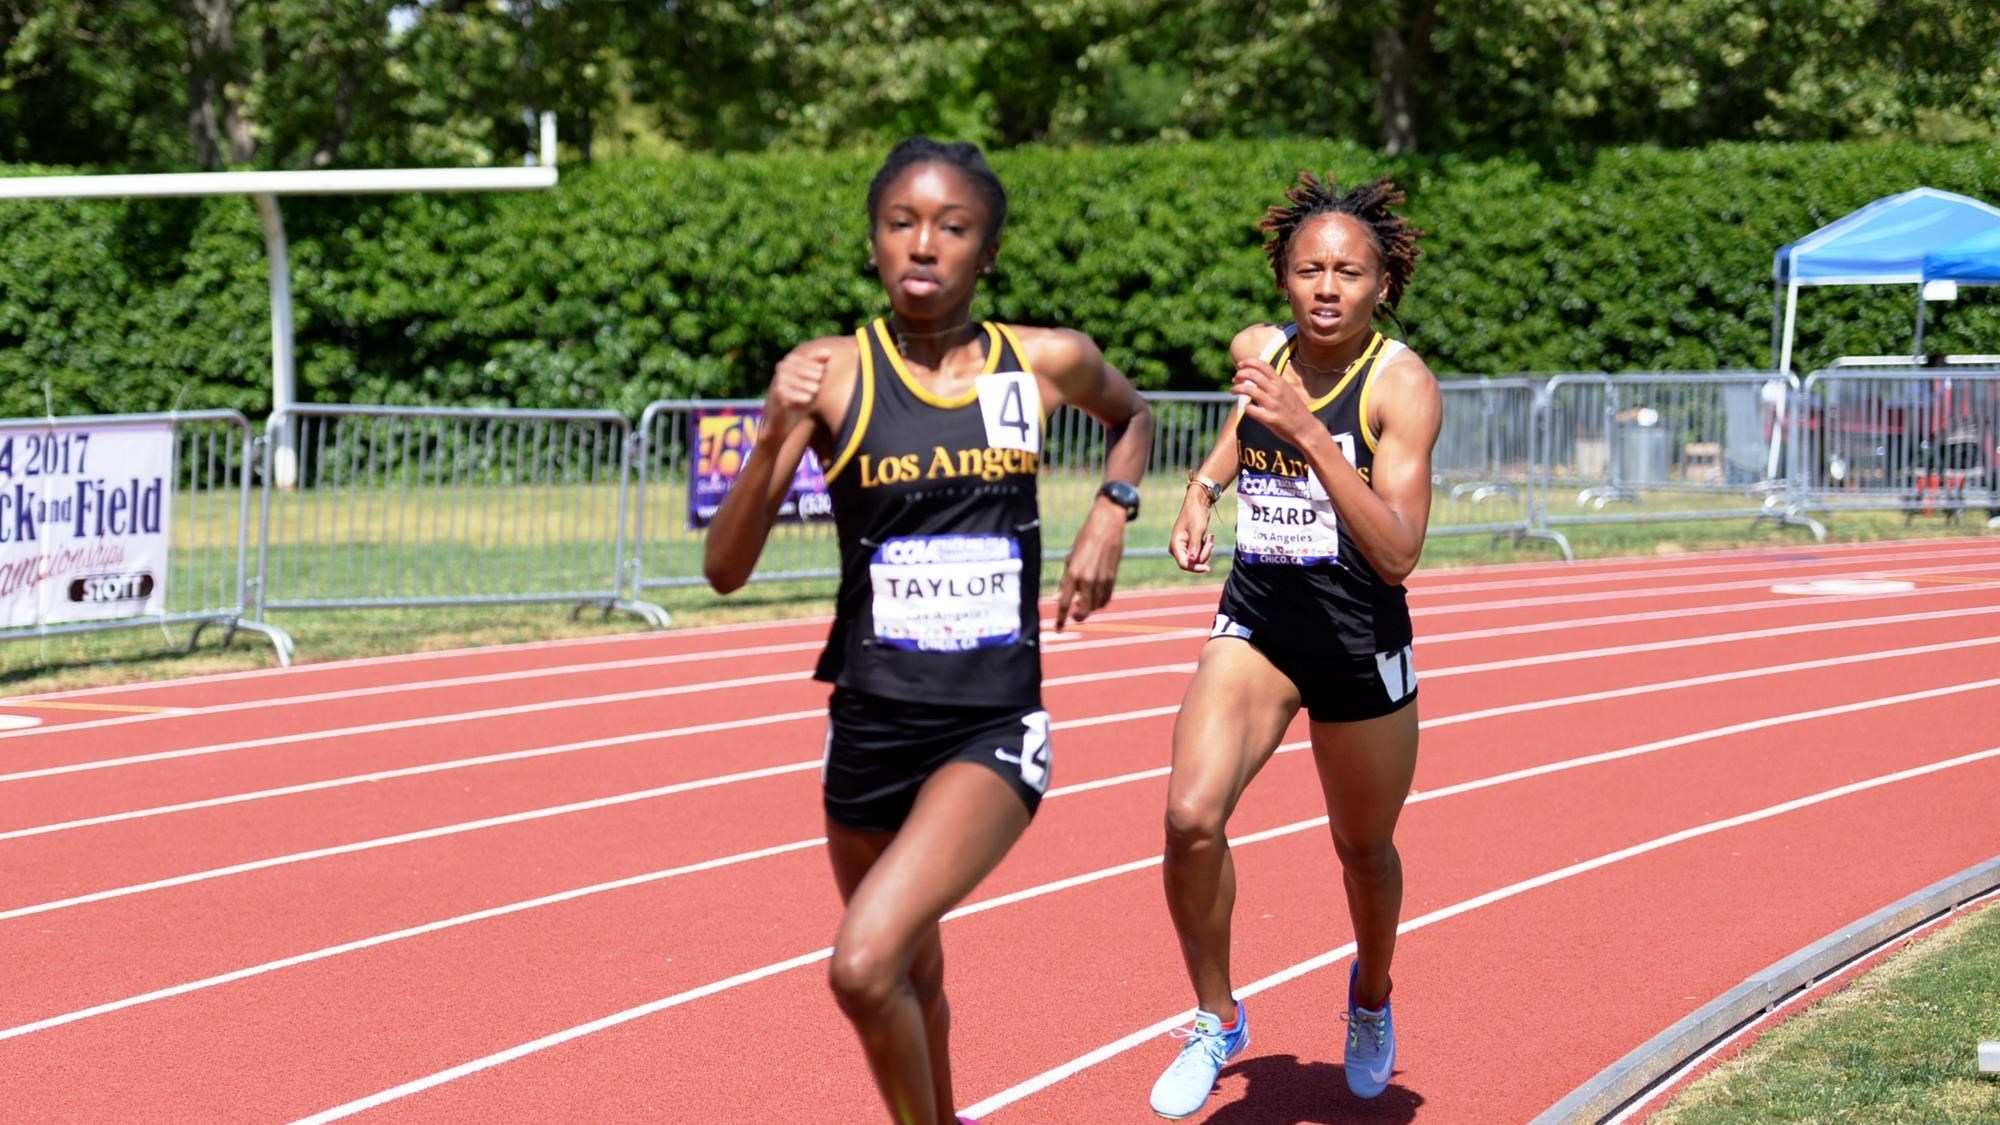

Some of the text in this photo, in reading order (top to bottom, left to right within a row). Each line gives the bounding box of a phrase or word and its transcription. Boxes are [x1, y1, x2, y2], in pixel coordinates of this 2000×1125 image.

[1000, 381, 1029, 442] 4
[26, 433, 89, 475] 2017
[859, 453, 920, 488] Los
[926, 446, 1038, 482] Angele
[38, 497, 71, 523] and
[73, 478, 162, 538] Field
[1251, 504, 1317, 526] BEARD
[1270, 532, 1313, 545] Angeles
[83, 577, 142, 601] STOTT
[886, 573, 1005, 599] TAYLOR
